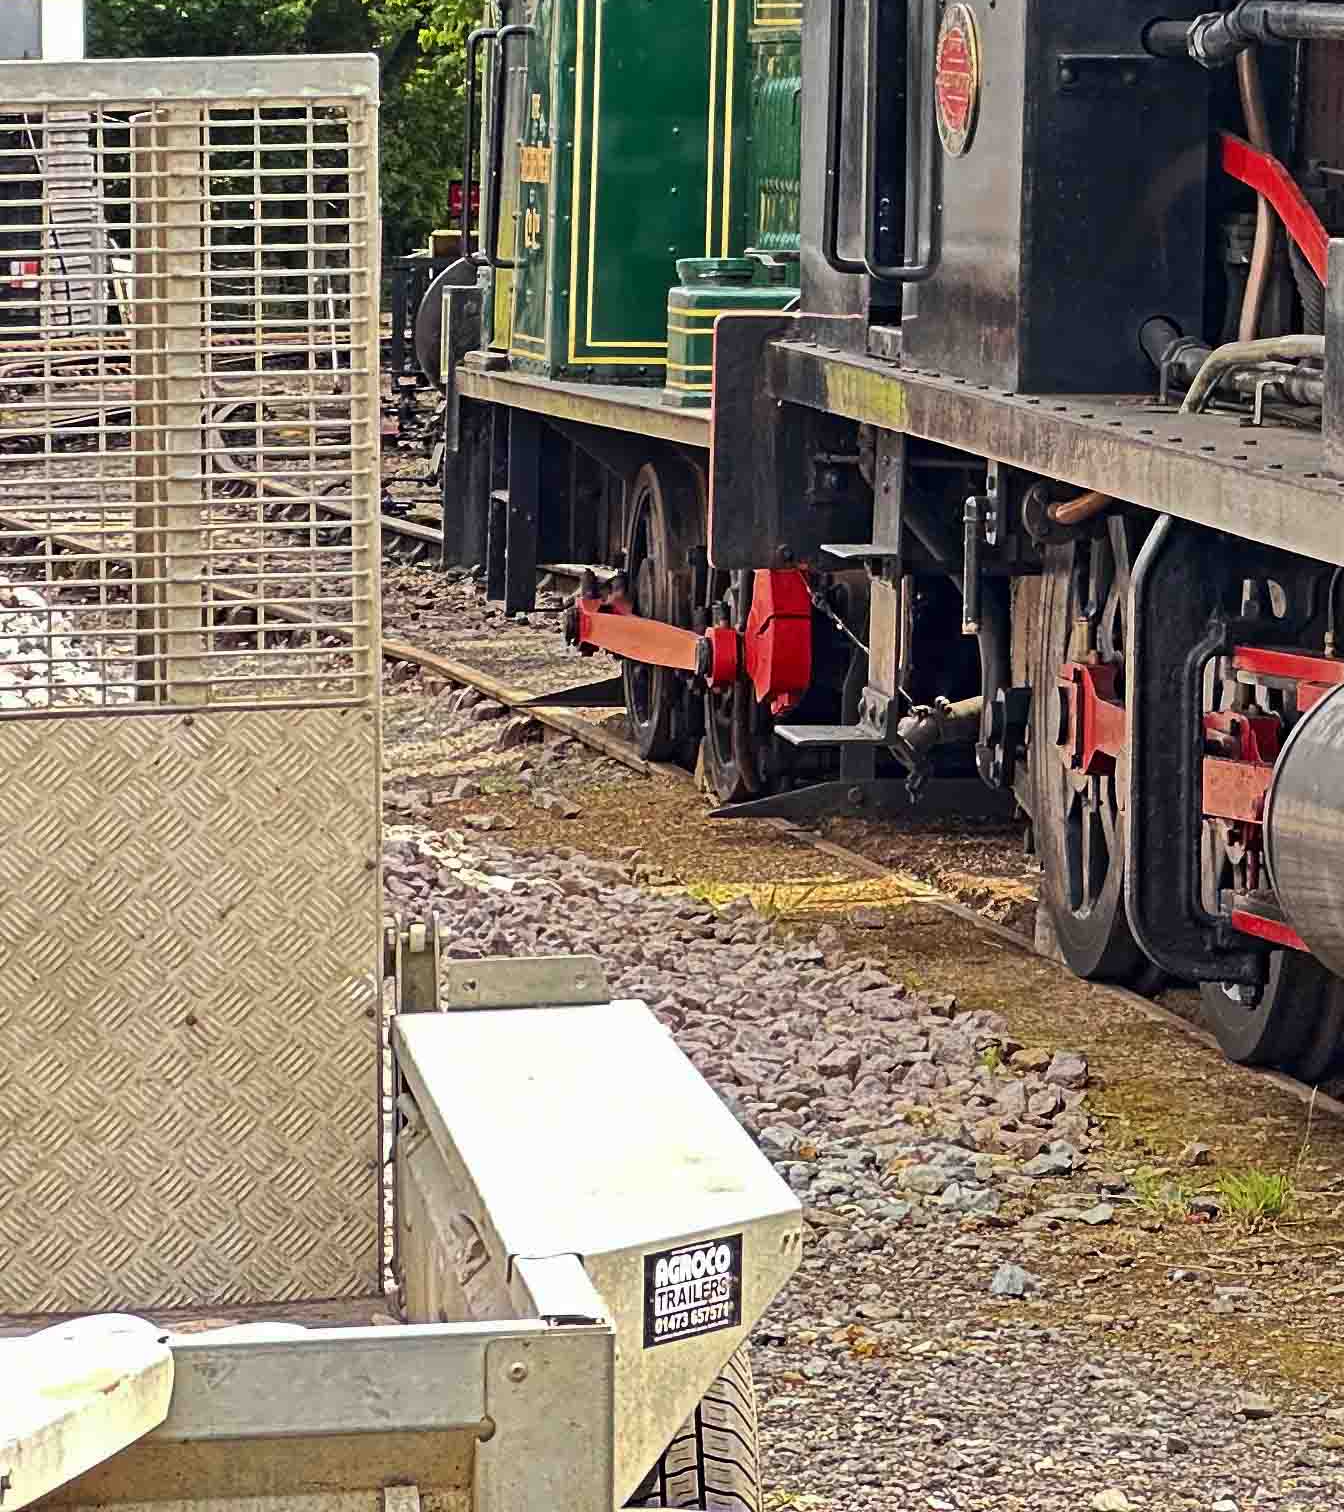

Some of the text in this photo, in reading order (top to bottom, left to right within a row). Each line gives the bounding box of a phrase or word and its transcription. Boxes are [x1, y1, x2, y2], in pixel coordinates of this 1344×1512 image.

[654, 1244, 731, 1288] AGROCO
[657, 1276, 728, 1312] TRAILERS
[654, 1301, 729, 1335] 01473 657571
